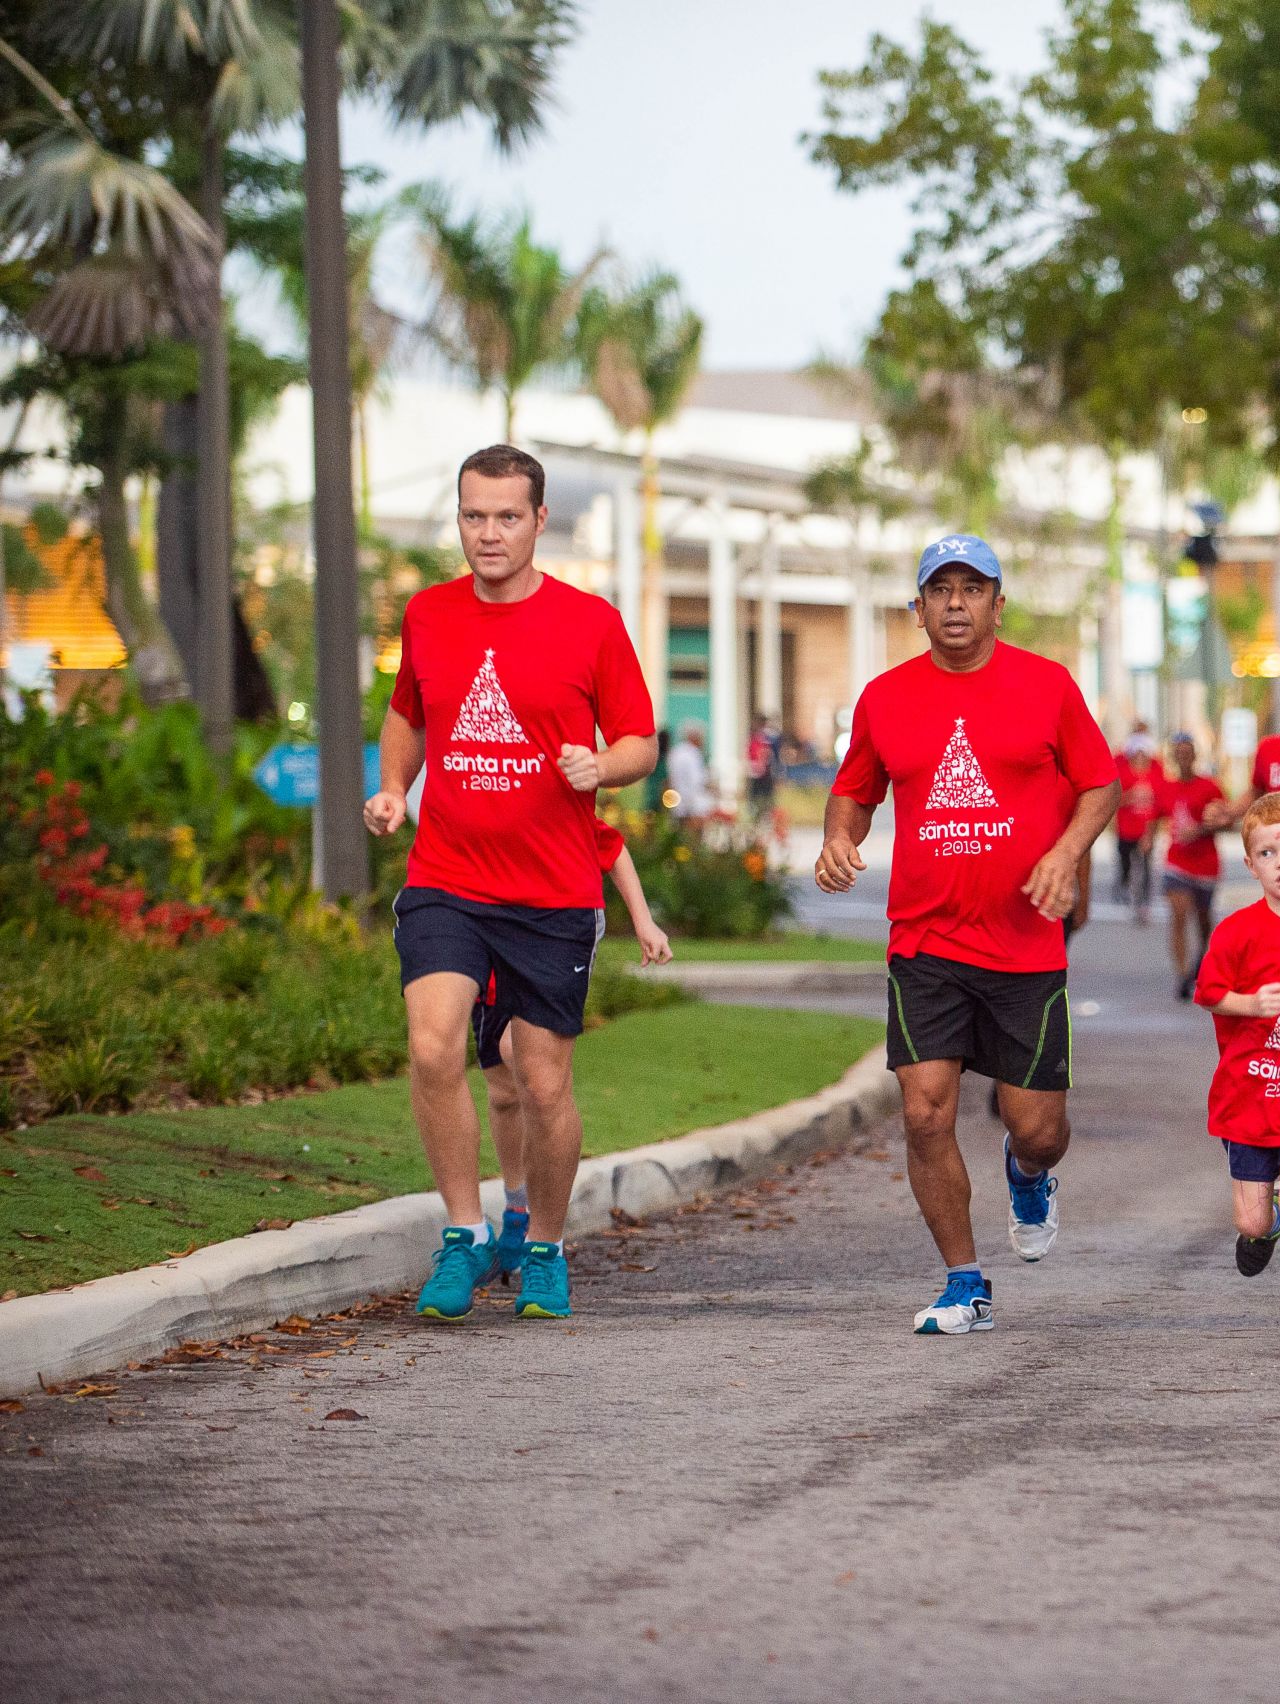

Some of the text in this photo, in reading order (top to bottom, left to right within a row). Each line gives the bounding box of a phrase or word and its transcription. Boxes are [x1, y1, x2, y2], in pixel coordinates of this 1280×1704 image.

[443, 754, 541, 774] santa run
[470, 775, 511, 792] 2019
[918, 820, 1011, 841] santa run
[942, 840, 982, 856] 2019
